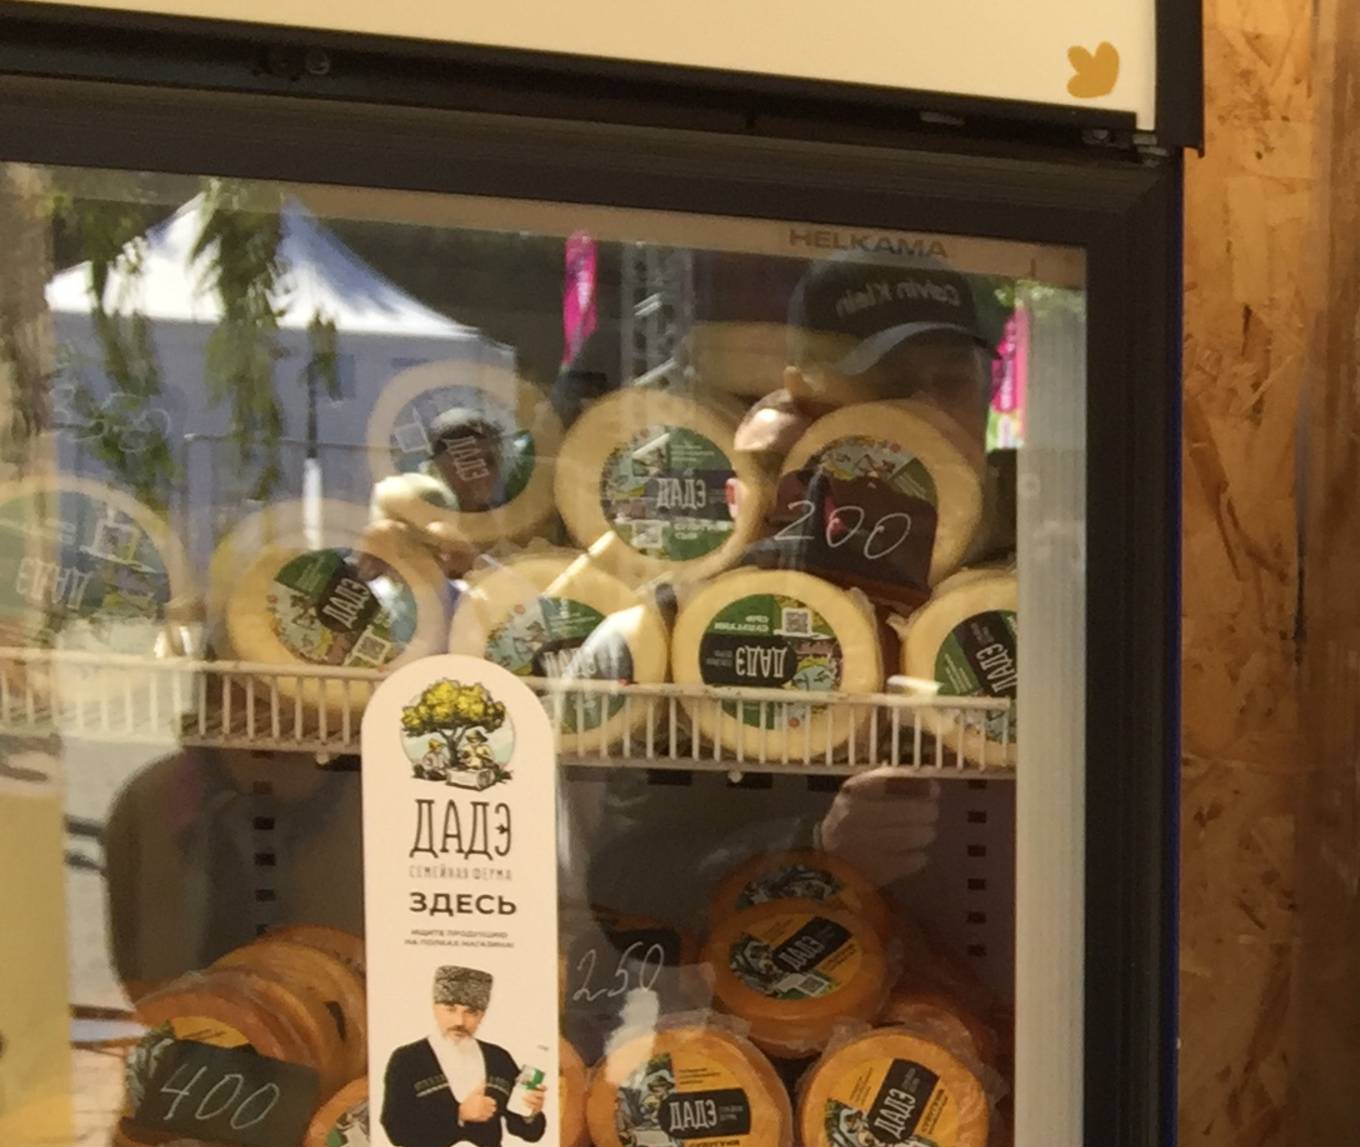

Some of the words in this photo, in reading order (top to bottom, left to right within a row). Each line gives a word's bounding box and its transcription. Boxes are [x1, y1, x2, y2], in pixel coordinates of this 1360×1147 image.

[789, 229, 948, 258] HELKAMA
[655, 477, 707, 510] ДАДЭ
[773, 499, 912, 560] 200
[321, 577, 371, 629] ДАДЭ
[735, 645, 788, 678] ДАДЭ
[408, 798, 512, 861] ДАДЭ
[408, 891, 518, 917] ЗДЕСЬ
[572, 941, 665, 1002] 250
[160, 1063, 280, 1130] 400
[669, 1098, 718, 1132] ДАДЭ
[873, 1088, 916, 1140] ДАДЭ
